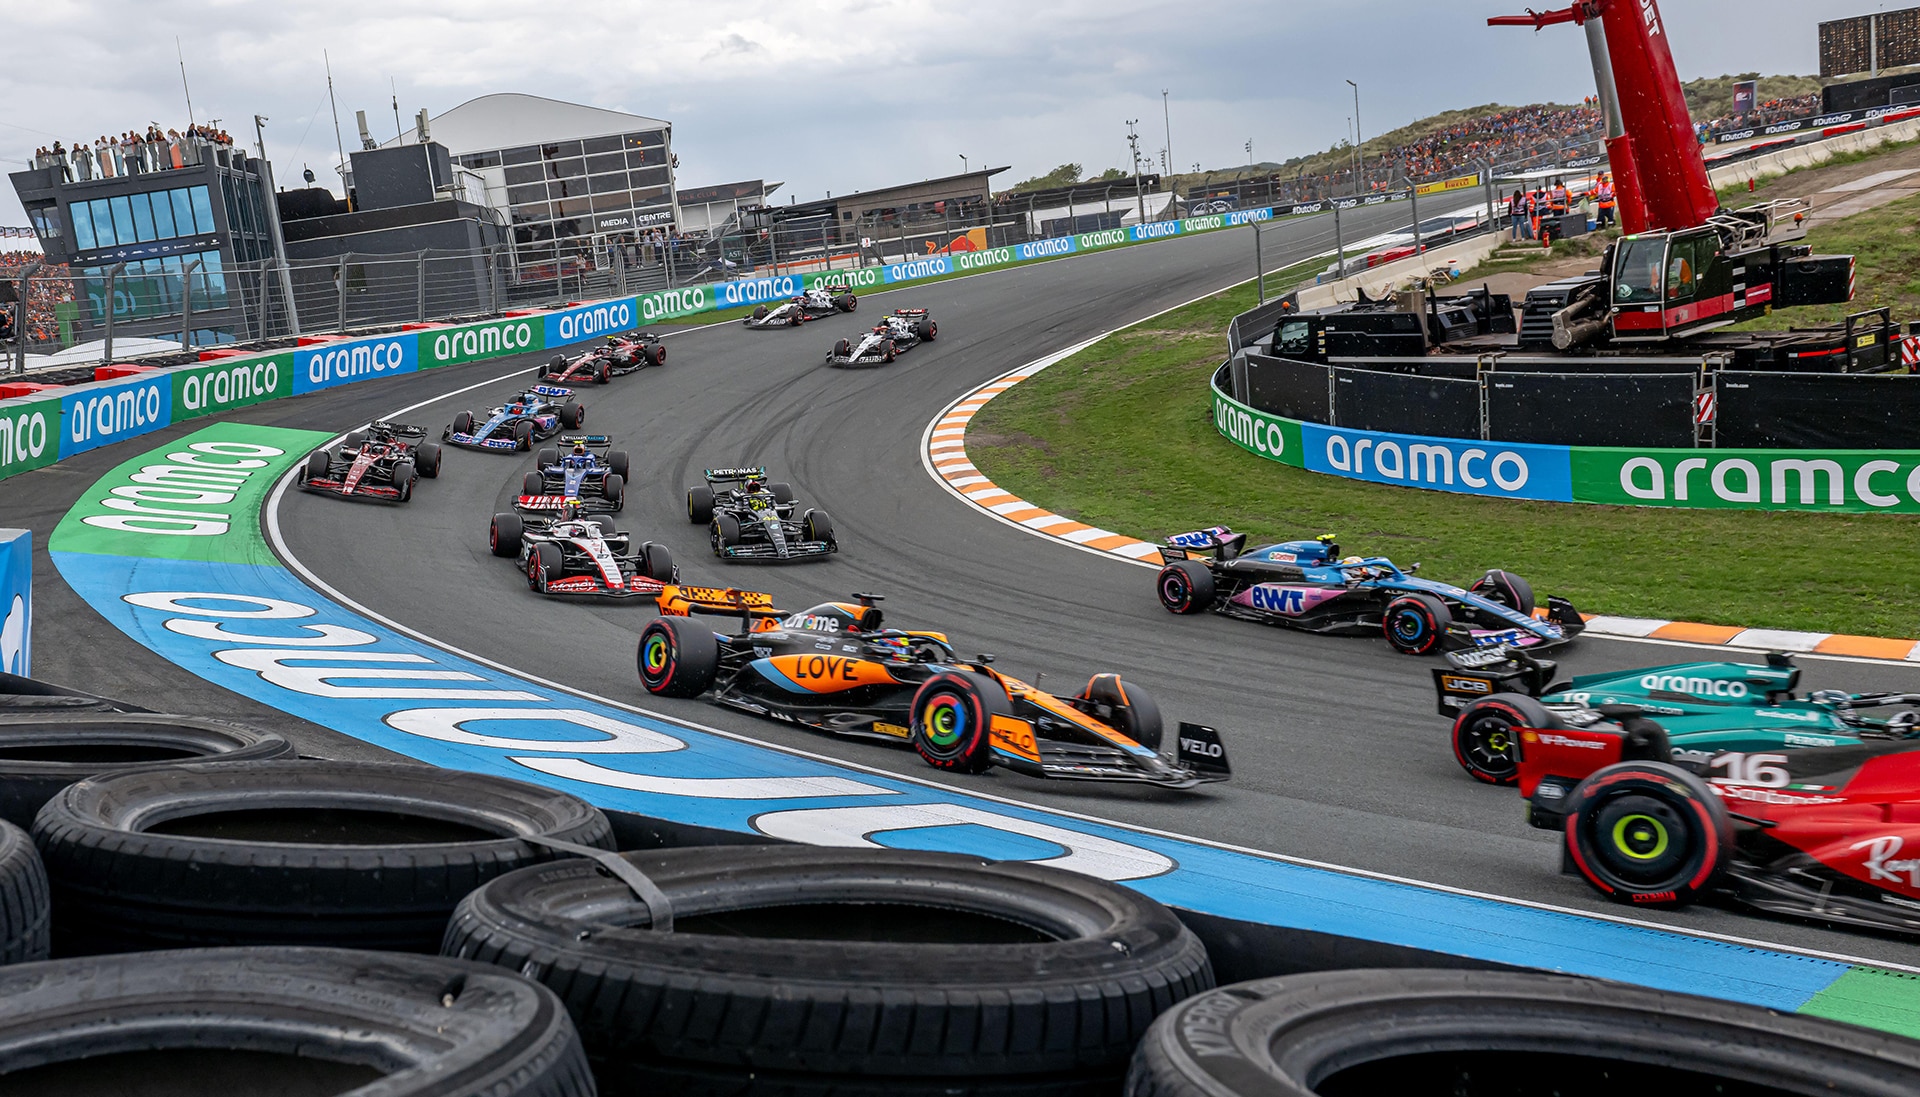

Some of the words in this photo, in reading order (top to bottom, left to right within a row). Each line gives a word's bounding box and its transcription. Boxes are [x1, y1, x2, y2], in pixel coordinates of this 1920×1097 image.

[1765, 122, 1801, 134] #DutchGP
[1812, 113, 1852, 126] #DutchGP
[1721, 130, 1754, 143] #DutchGP
[600, 217, 629, 228] MEDIA
[639, 211, 671, 222] CENTRE
[1230, 208, 1268, 224] aramco
[1292, 203, 1322, 215] #DutchGP
[1136, 220, 1175, 239] aramco
[1185, 214, 1221, 232] aramco
[1023, 238, 1069, 258] aramco
[1081, 228, 1125, 248] aramco
[892, 258, 945, 280] aramco
[960, 248, 1010, 269] aramco
[725, 275, 794, 304] aramco
[559, 303, 630, 340] aramco
[434, 322, 531, 361] aramco
[309, 342, 403, 384] aramco
[183, 362, 278, 411] aramco
[71, 385, 160, 443] aramco
[1216, 397, 1284, 457] aramco
[713, 467, 757, 475] PETRONAS
[1326, 435, 1529, 491] aramco
[80, 442, 285, 536] aramco
[1252, 586, 1306, 613] BWT
[797, 656, 858, 681] LOVE
[1448, 680, 1489, 692] JCB
[1640, 675, 1748, 698] aramco
[122, 591, 1178, 882] aramco
[1180, 738, 1222, 758] VELO
[1711, 752, 1790, 788] 16
